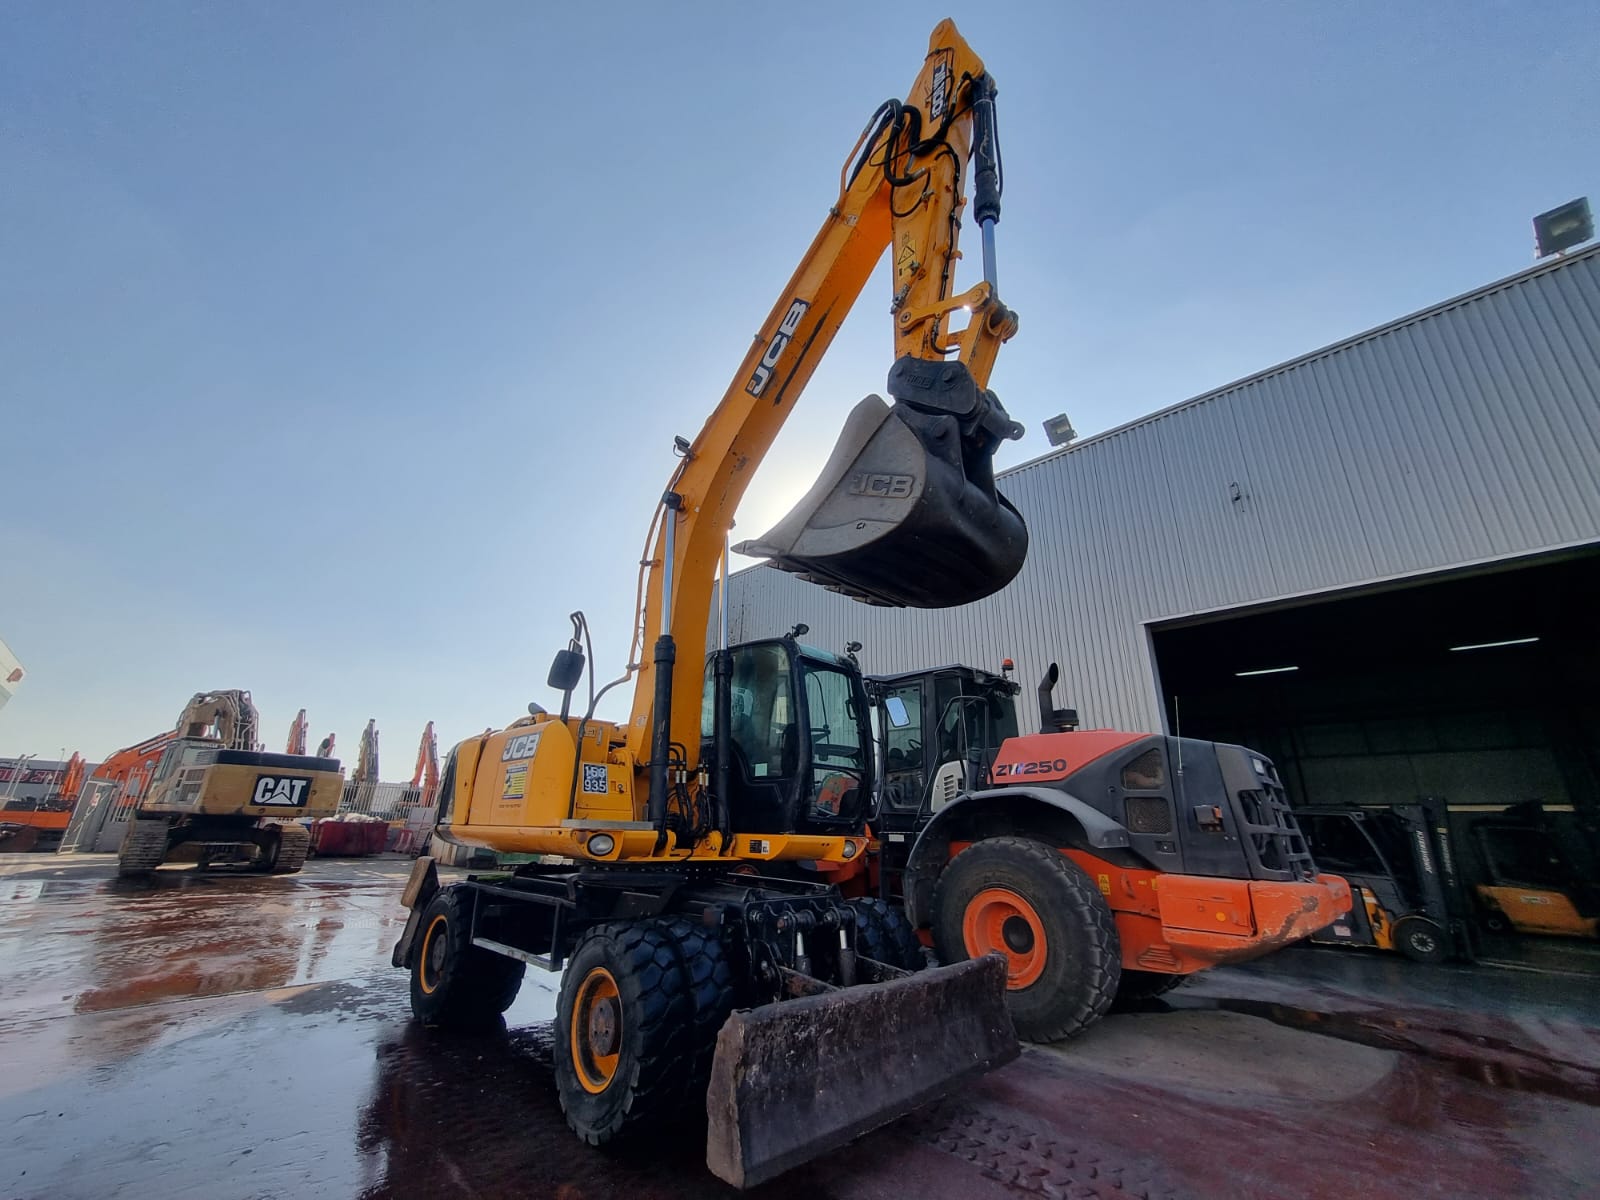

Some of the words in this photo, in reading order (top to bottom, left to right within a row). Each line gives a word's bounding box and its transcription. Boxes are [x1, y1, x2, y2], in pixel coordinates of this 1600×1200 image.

[751, 301, 808, 395] JCB
[849, 472, 915, 498] JCB
[502, 733, 540, 761] JCB
[254, 777, 308, 805] CAT
